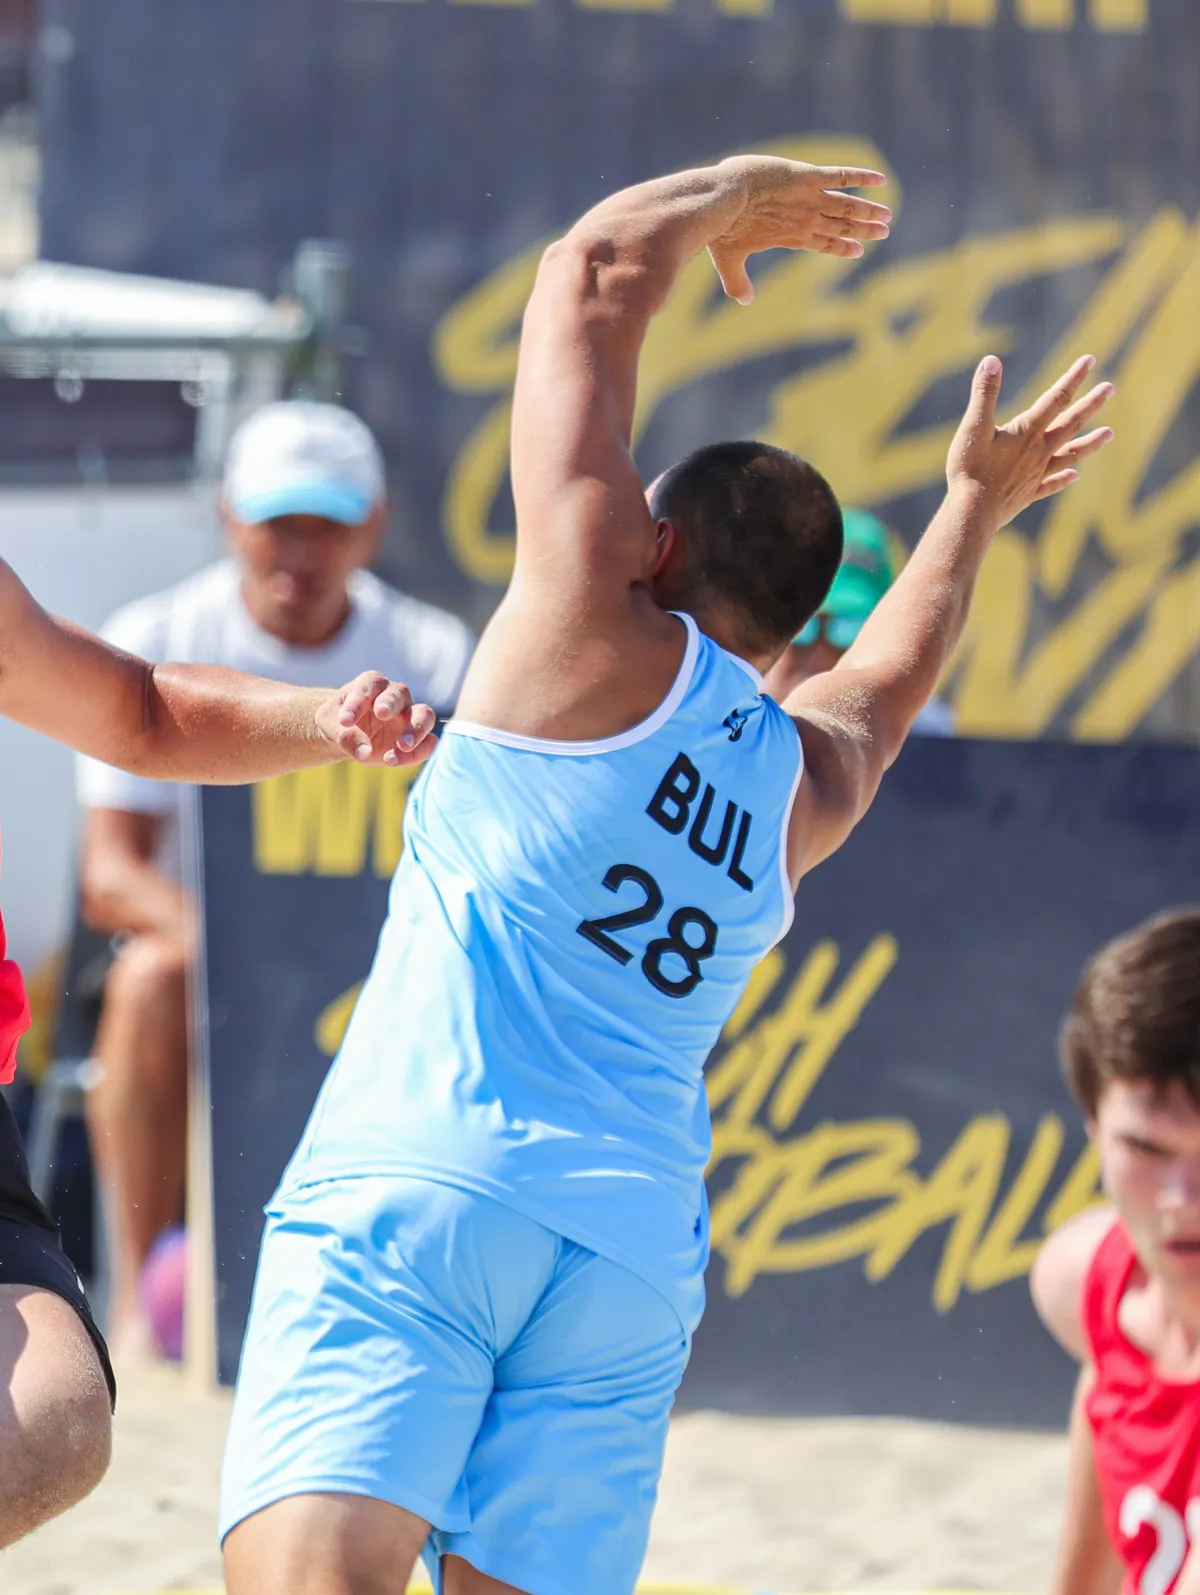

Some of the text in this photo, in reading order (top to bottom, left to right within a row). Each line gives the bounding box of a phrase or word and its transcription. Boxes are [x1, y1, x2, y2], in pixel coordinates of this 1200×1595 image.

[646, 751, 754, 893] BUL
[576, 863, 718, 998] 28
[1118, 1484, 1200, 1595] 2
